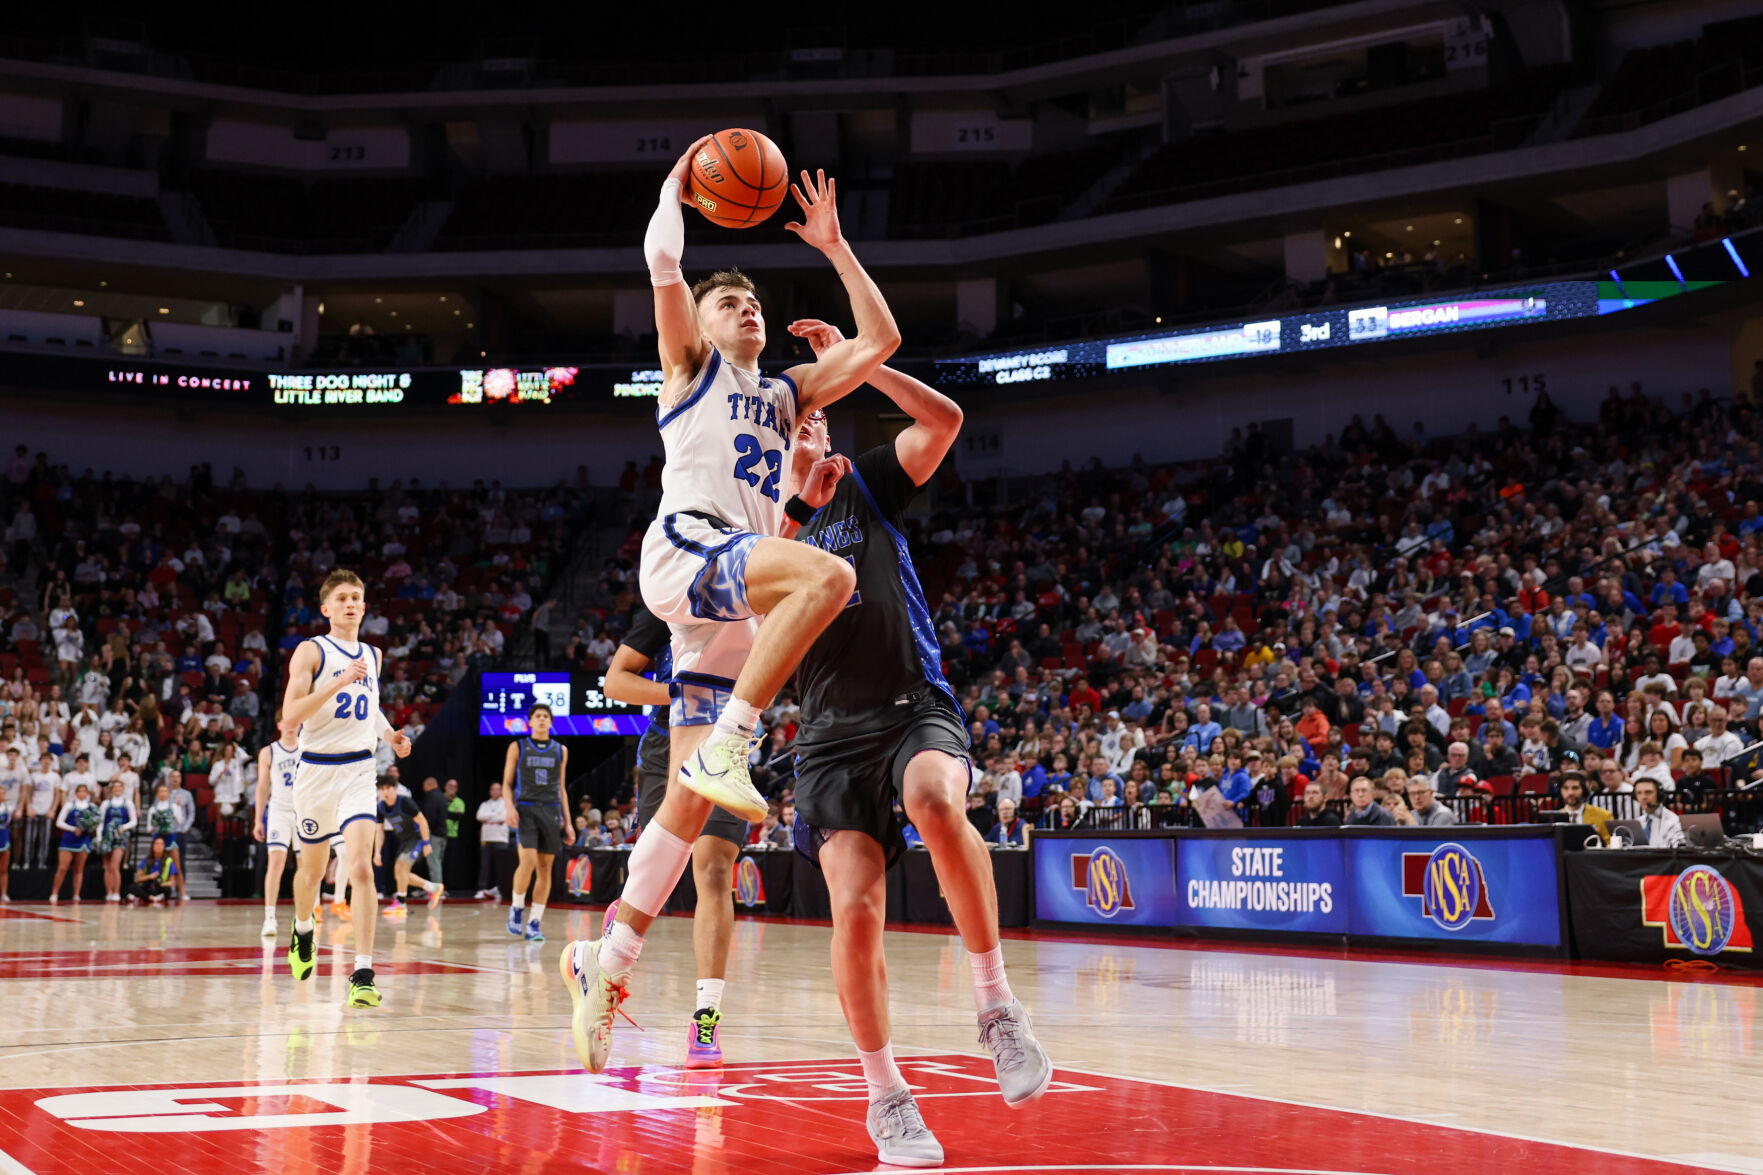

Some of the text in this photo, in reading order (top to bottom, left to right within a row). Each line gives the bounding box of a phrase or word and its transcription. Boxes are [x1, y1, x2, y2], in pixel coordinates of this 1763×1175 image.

[1447, 40, 1486, 61] 216
[958, 127, 995, 142] 215
[331, 146, 366, 161] 213
[636, 137, 671, 152] 214
[1389, 305, 1459, 329] BERGAN
[1300, 322, 1330, 342] 3rd
[108, 370, 251, 391] LIVE IN CONCERT
[268, 374, 313, 390] THREE
[316, 374, 349, 390] DOG
[352, 374, 397, 389] NIGHT
[995, 367, 1032, 384] CLASS
[1502, 374, 1545, 394] 115
[274, 388, 404, 404] LITTLE RIVER BAND
[966, 434, 998, 450] 114
[305, 446, 340, 461] 113
[734, 434, 782, 503] 22
[335, 692, 368, 720] 20
[544, 692, 566, 708] 38
[1231, 846, 1283, 878] STATE
[1187, 878, 1332, 914] CHAMPIONSHIPS
